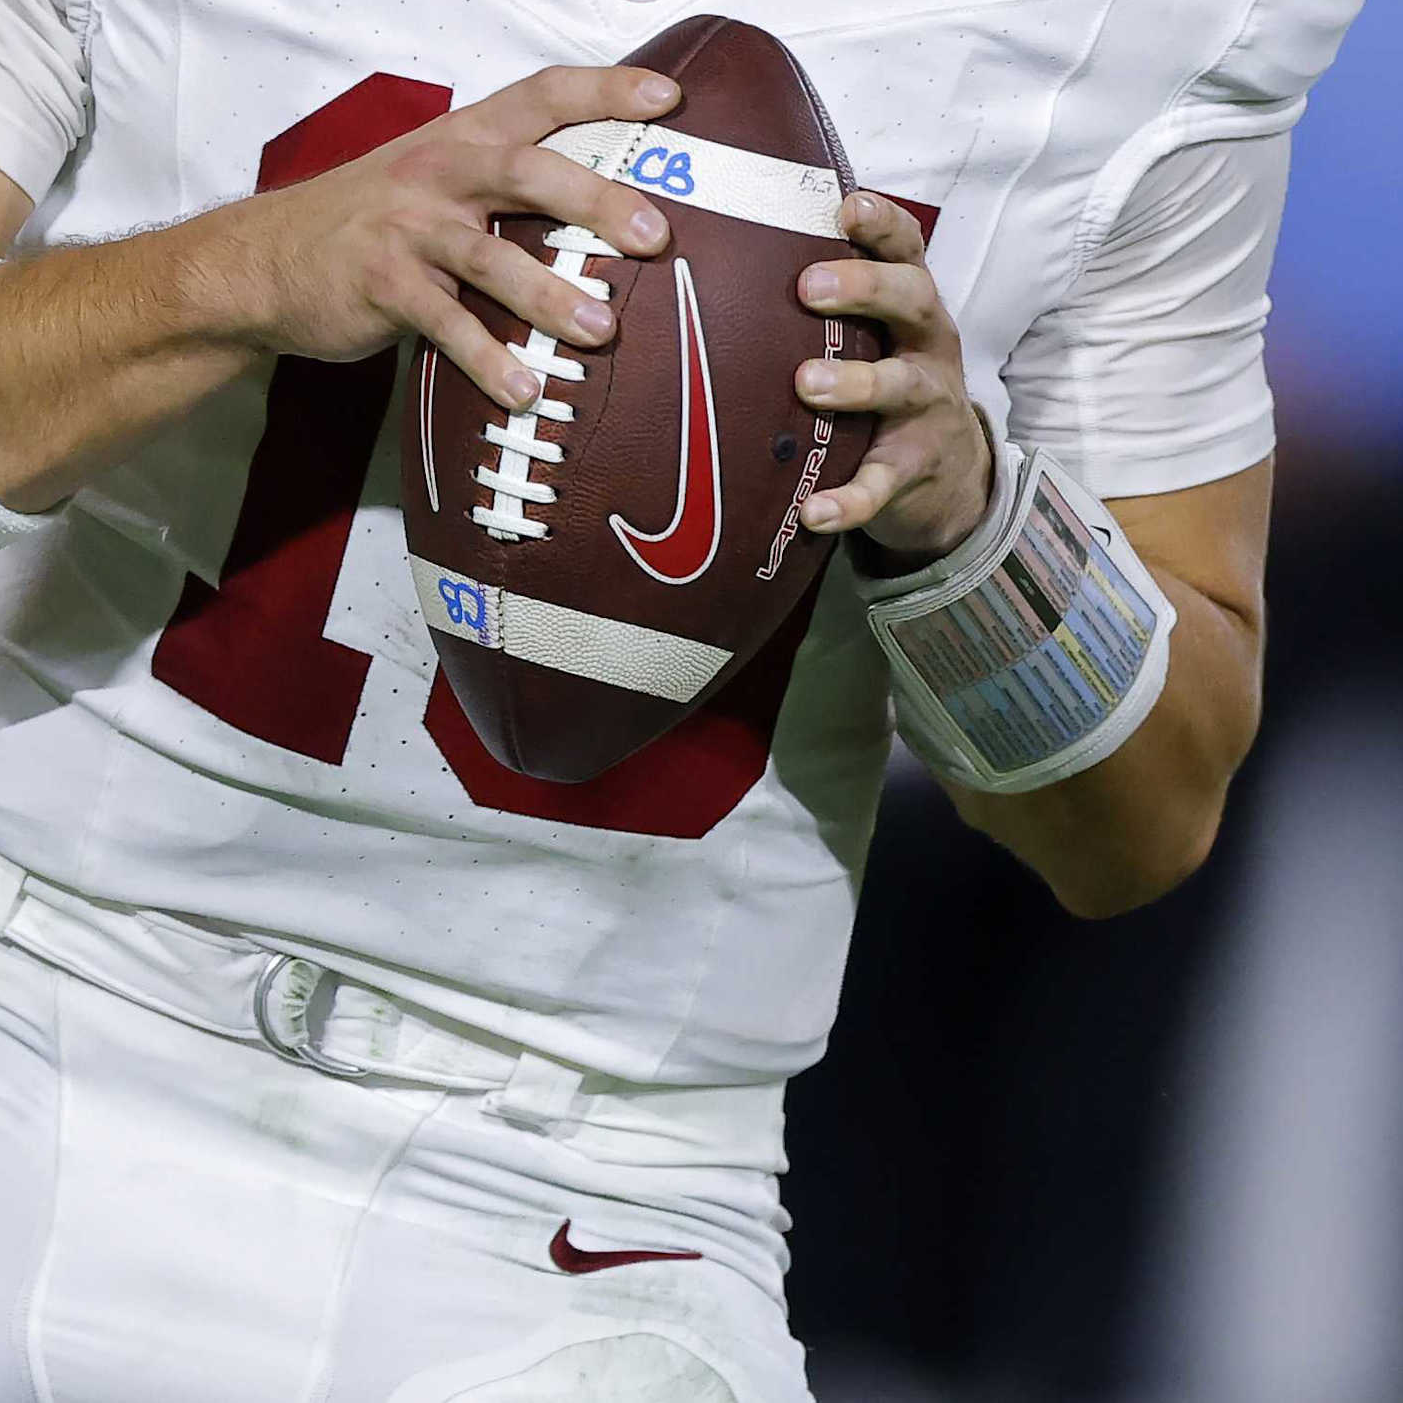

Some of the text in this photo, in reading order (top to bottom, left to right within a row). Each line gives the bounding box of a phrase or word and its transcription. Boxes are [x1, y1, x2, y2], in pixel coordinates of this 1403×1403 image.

[629, 146, 695, 196] CB
[756, 446, 828, 581] VAPOR
[438, 578, 486, 630] CB
